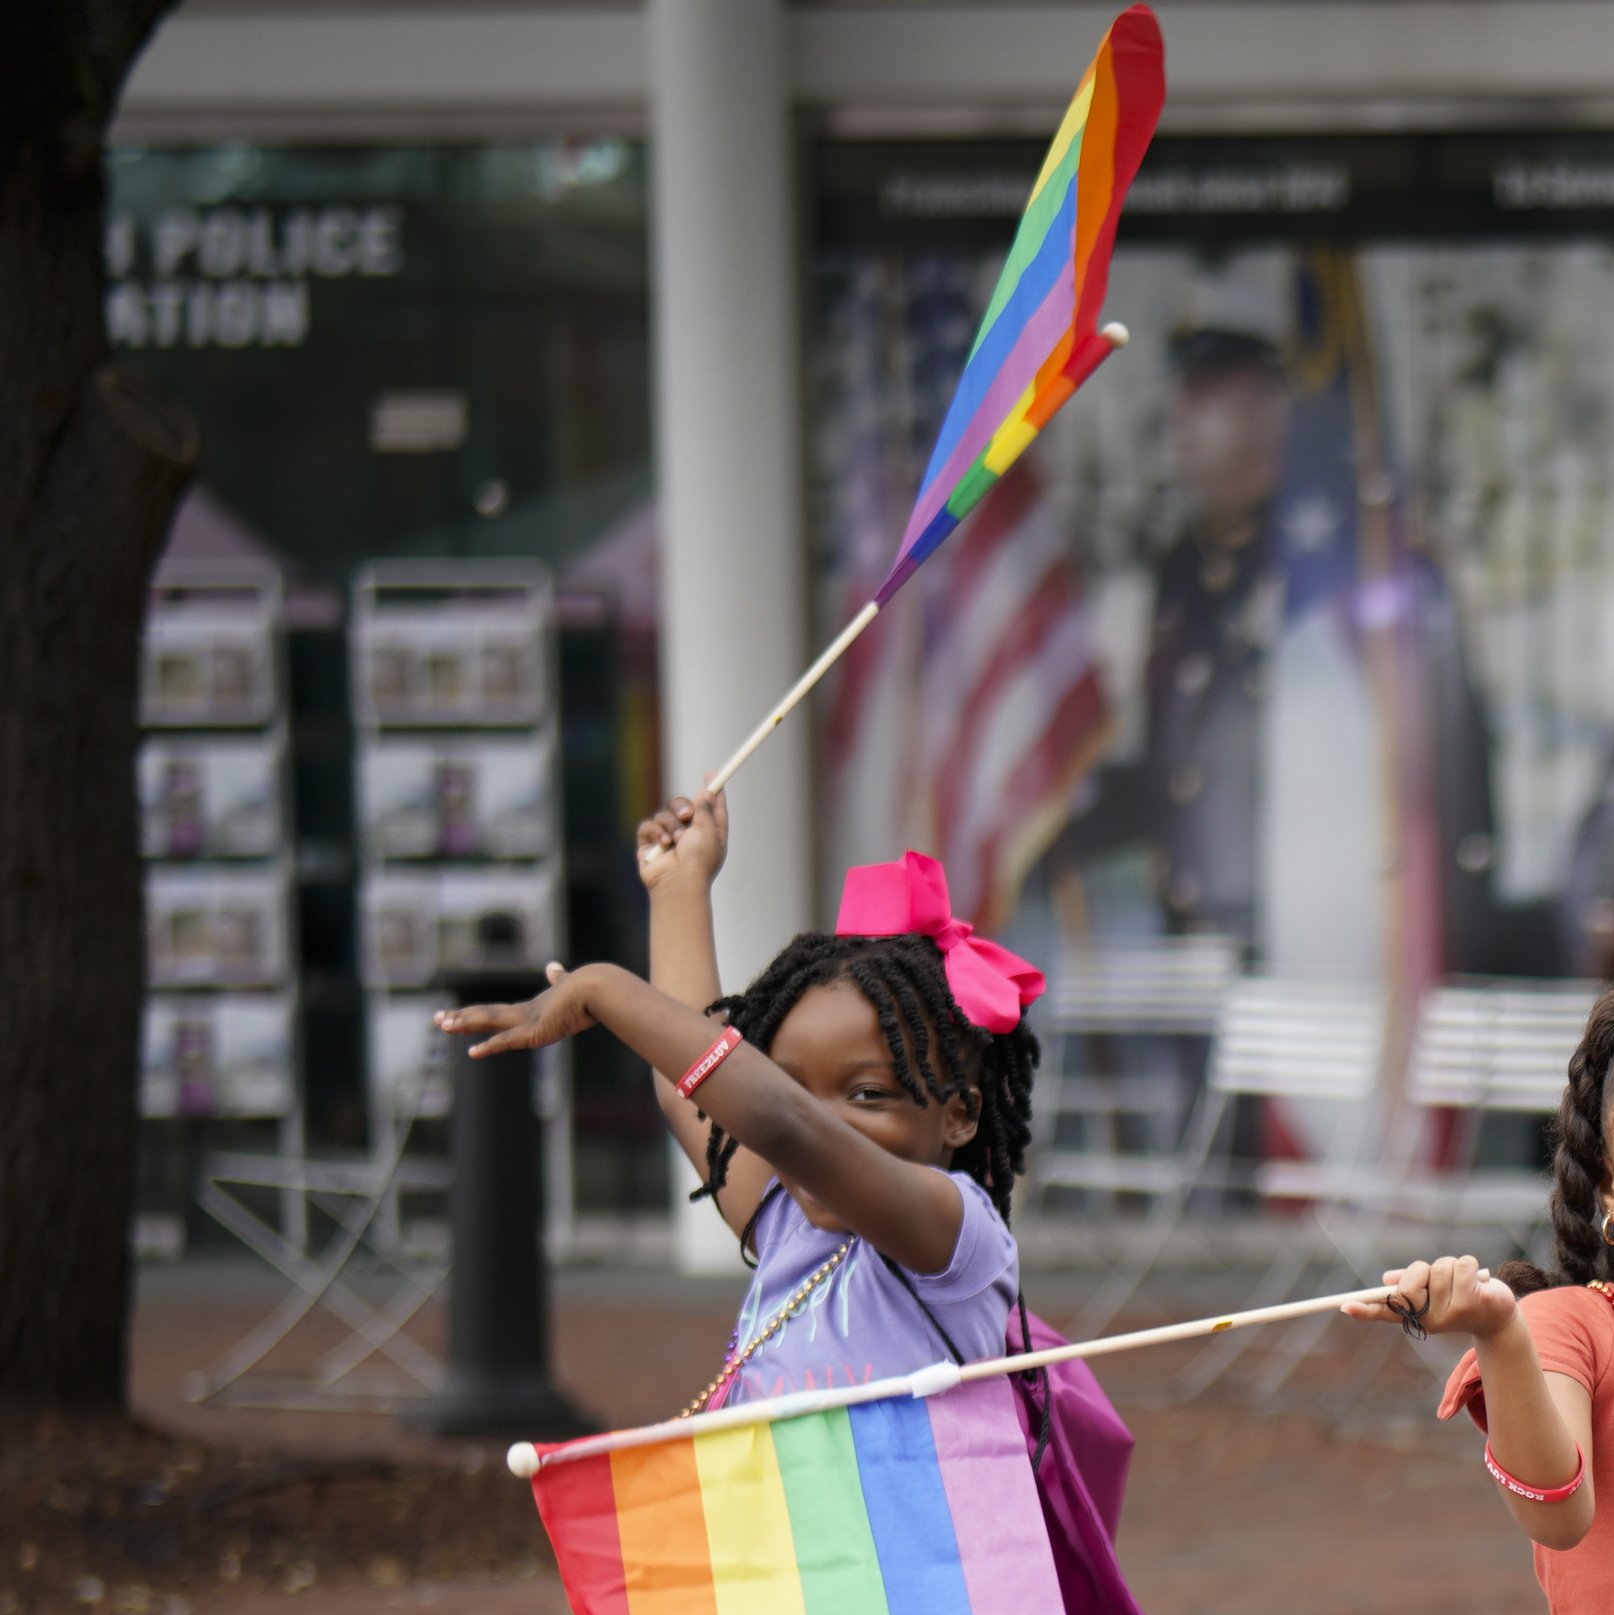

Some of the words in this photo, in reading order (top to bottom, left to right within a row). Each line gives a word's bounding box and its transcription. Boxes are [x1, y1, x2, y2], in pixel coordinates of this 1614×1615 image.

[153, 207, 402, 279] POLICE
[103, 280, 310, 350] ATION
[1508, 1482, 1545, 1501] ROCK
